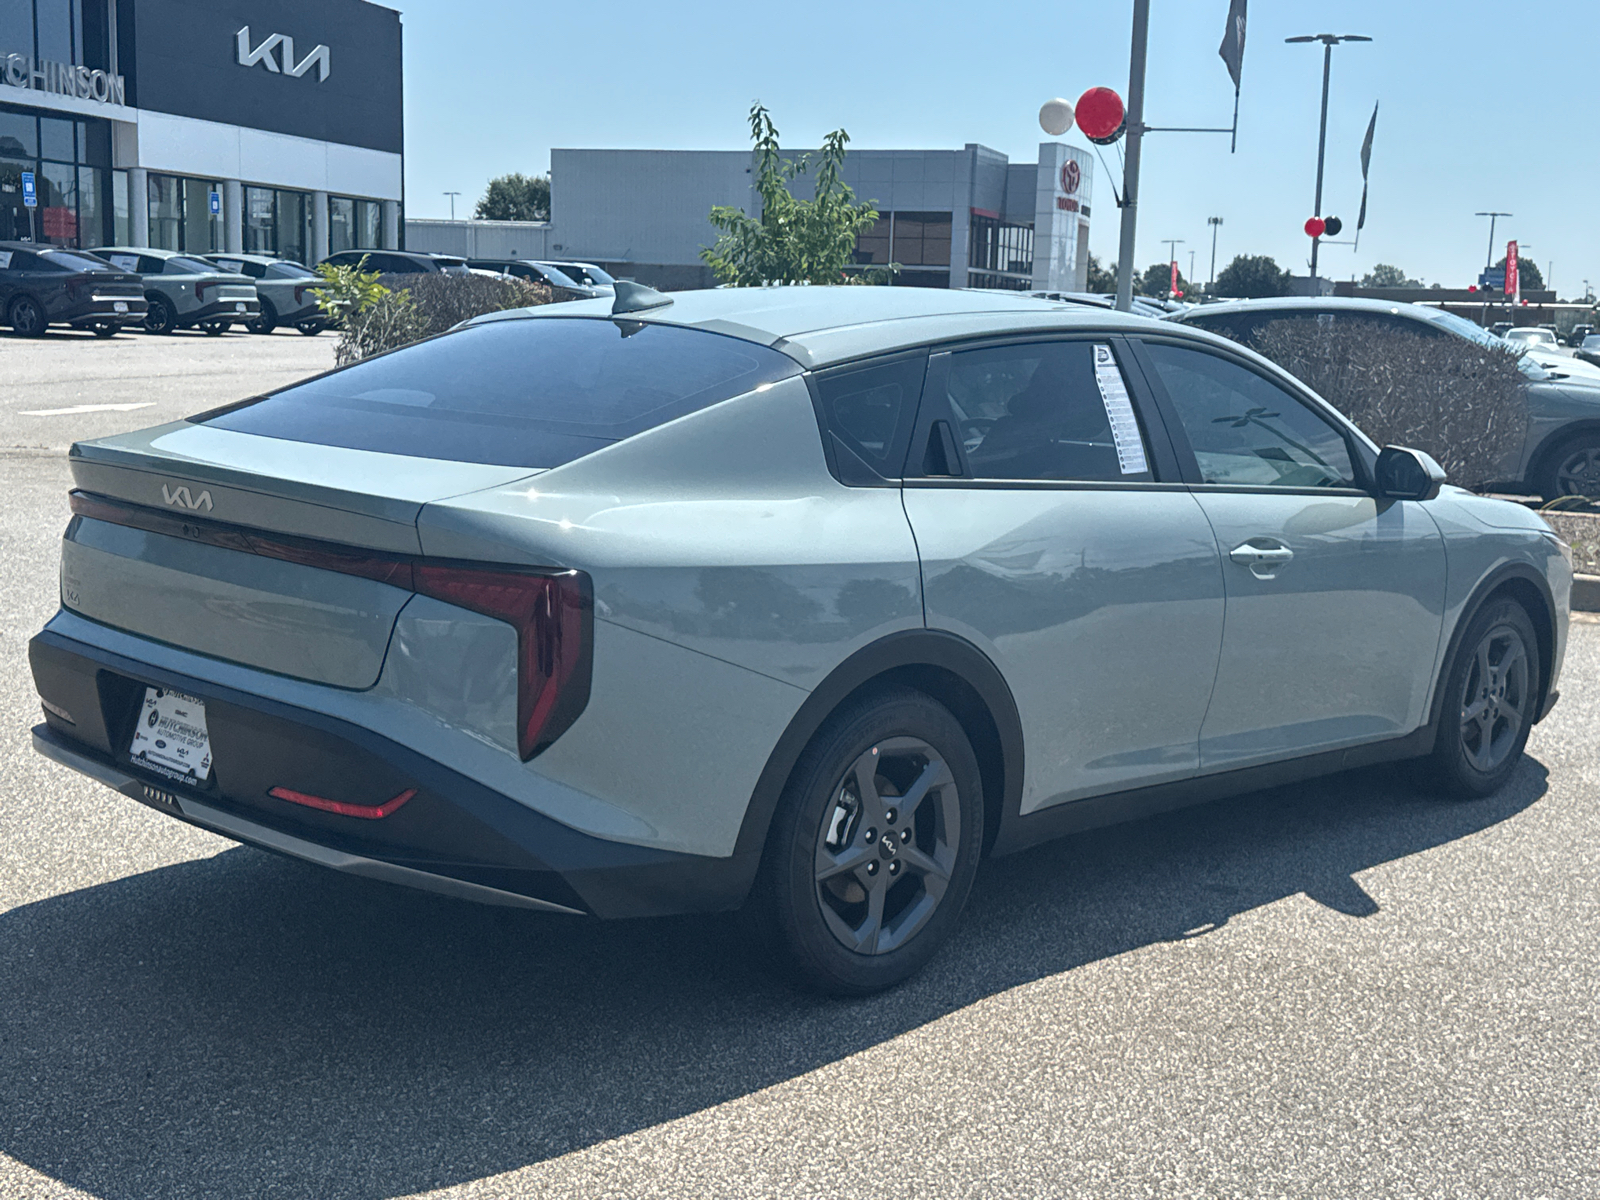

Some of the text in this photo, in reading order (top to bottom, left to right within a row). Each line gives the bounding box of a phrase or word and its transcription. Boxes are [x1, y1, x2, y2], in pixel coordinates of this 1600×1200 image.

[237, 25, 330, 83] KIA
[161, 483, 214, 512] KIA
[157, 729, 187, 743] AUTOMOTIVE
[187, 738, 204, 749] GROUP
[158, 716, 208, 742] HUTCHINSON
[881, 835, 897, 855] KIA
